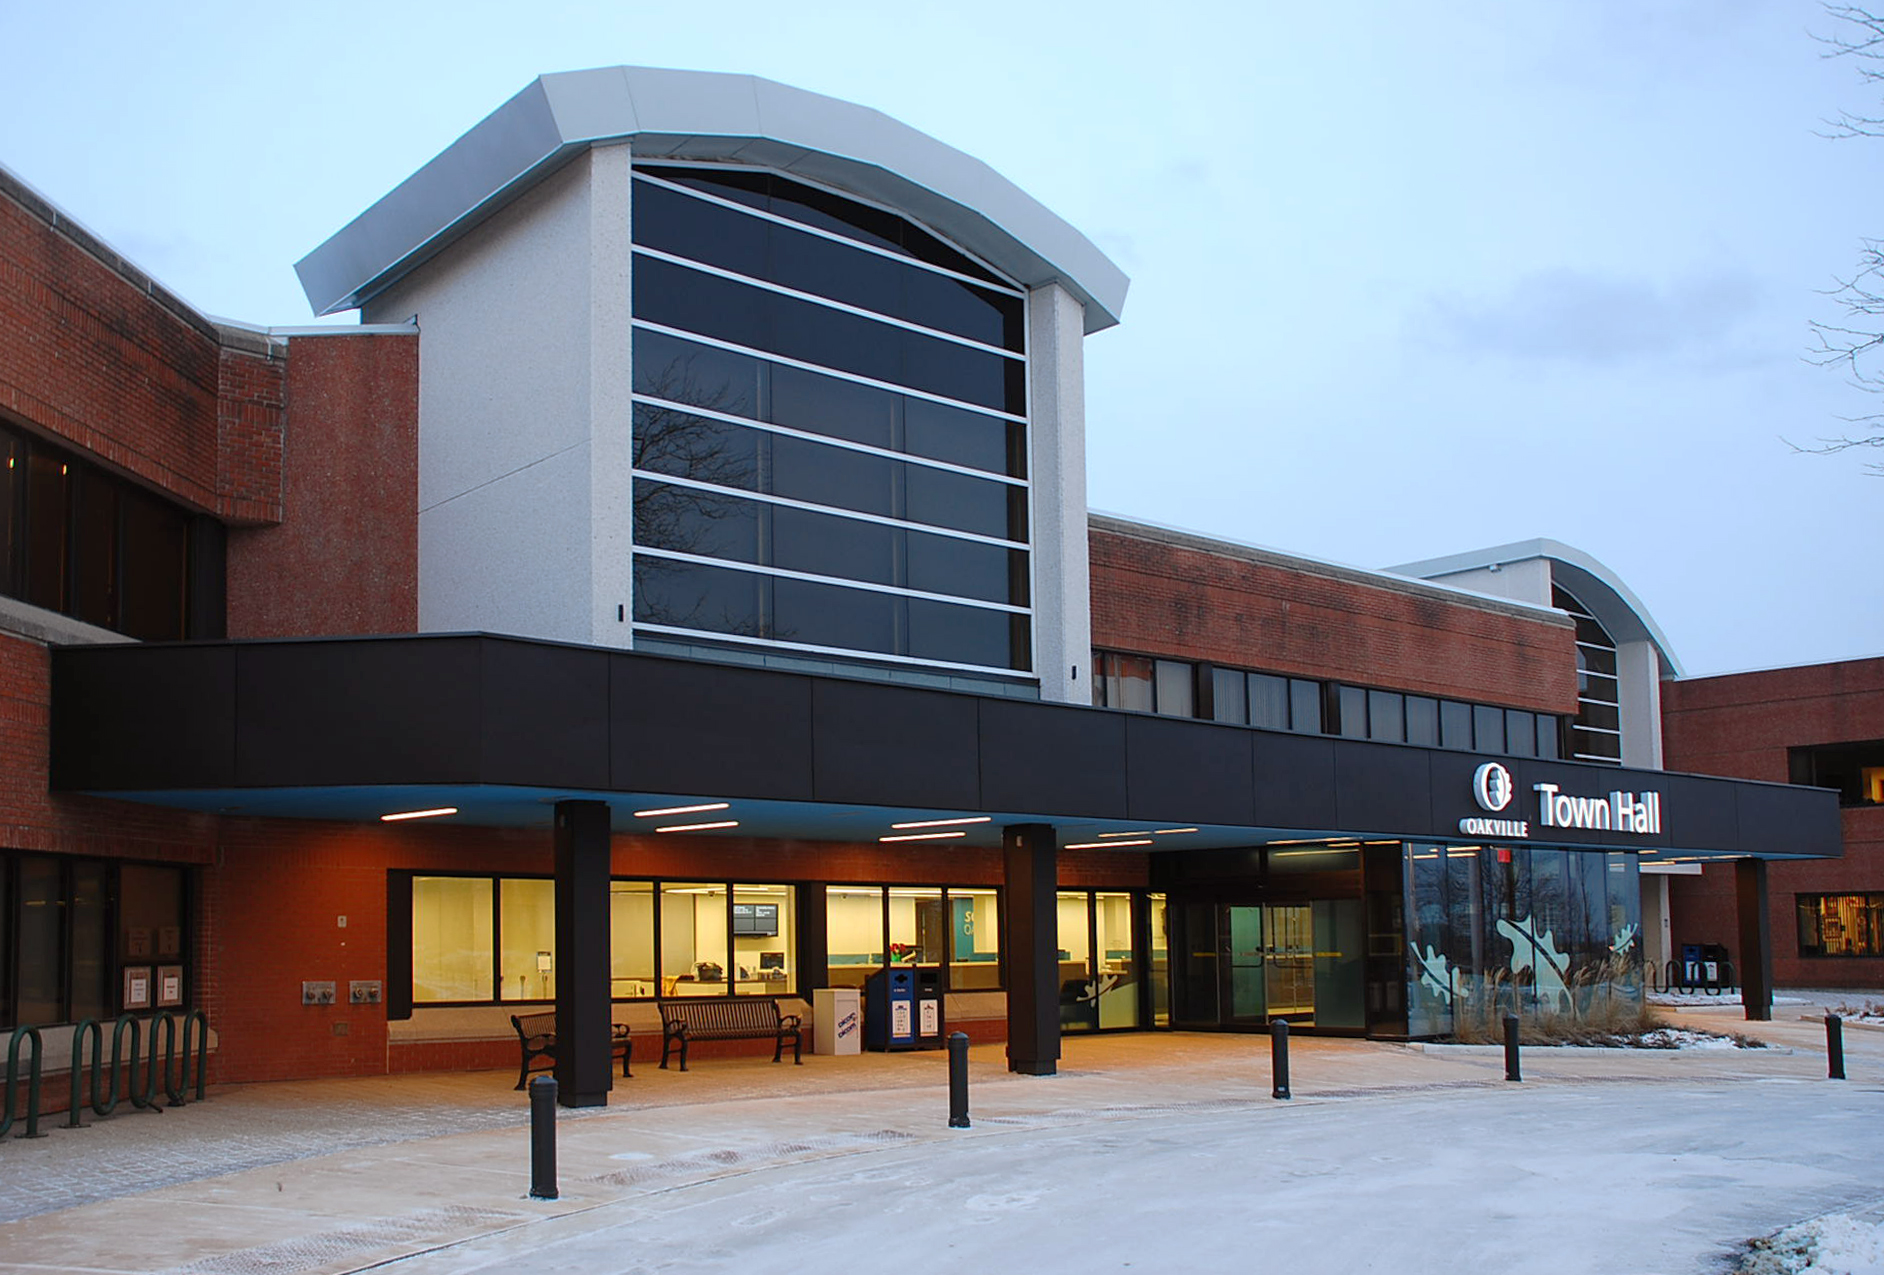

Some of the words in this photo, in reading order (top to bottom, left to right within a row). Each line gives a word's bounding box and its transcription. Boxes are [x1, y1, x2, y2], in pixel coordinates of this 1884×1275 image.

[1533, 783, 1610, 830] Town
[1611, 790, 1660, 833] Hall
[1460, 818, 1528, 837] OAKVILLE
